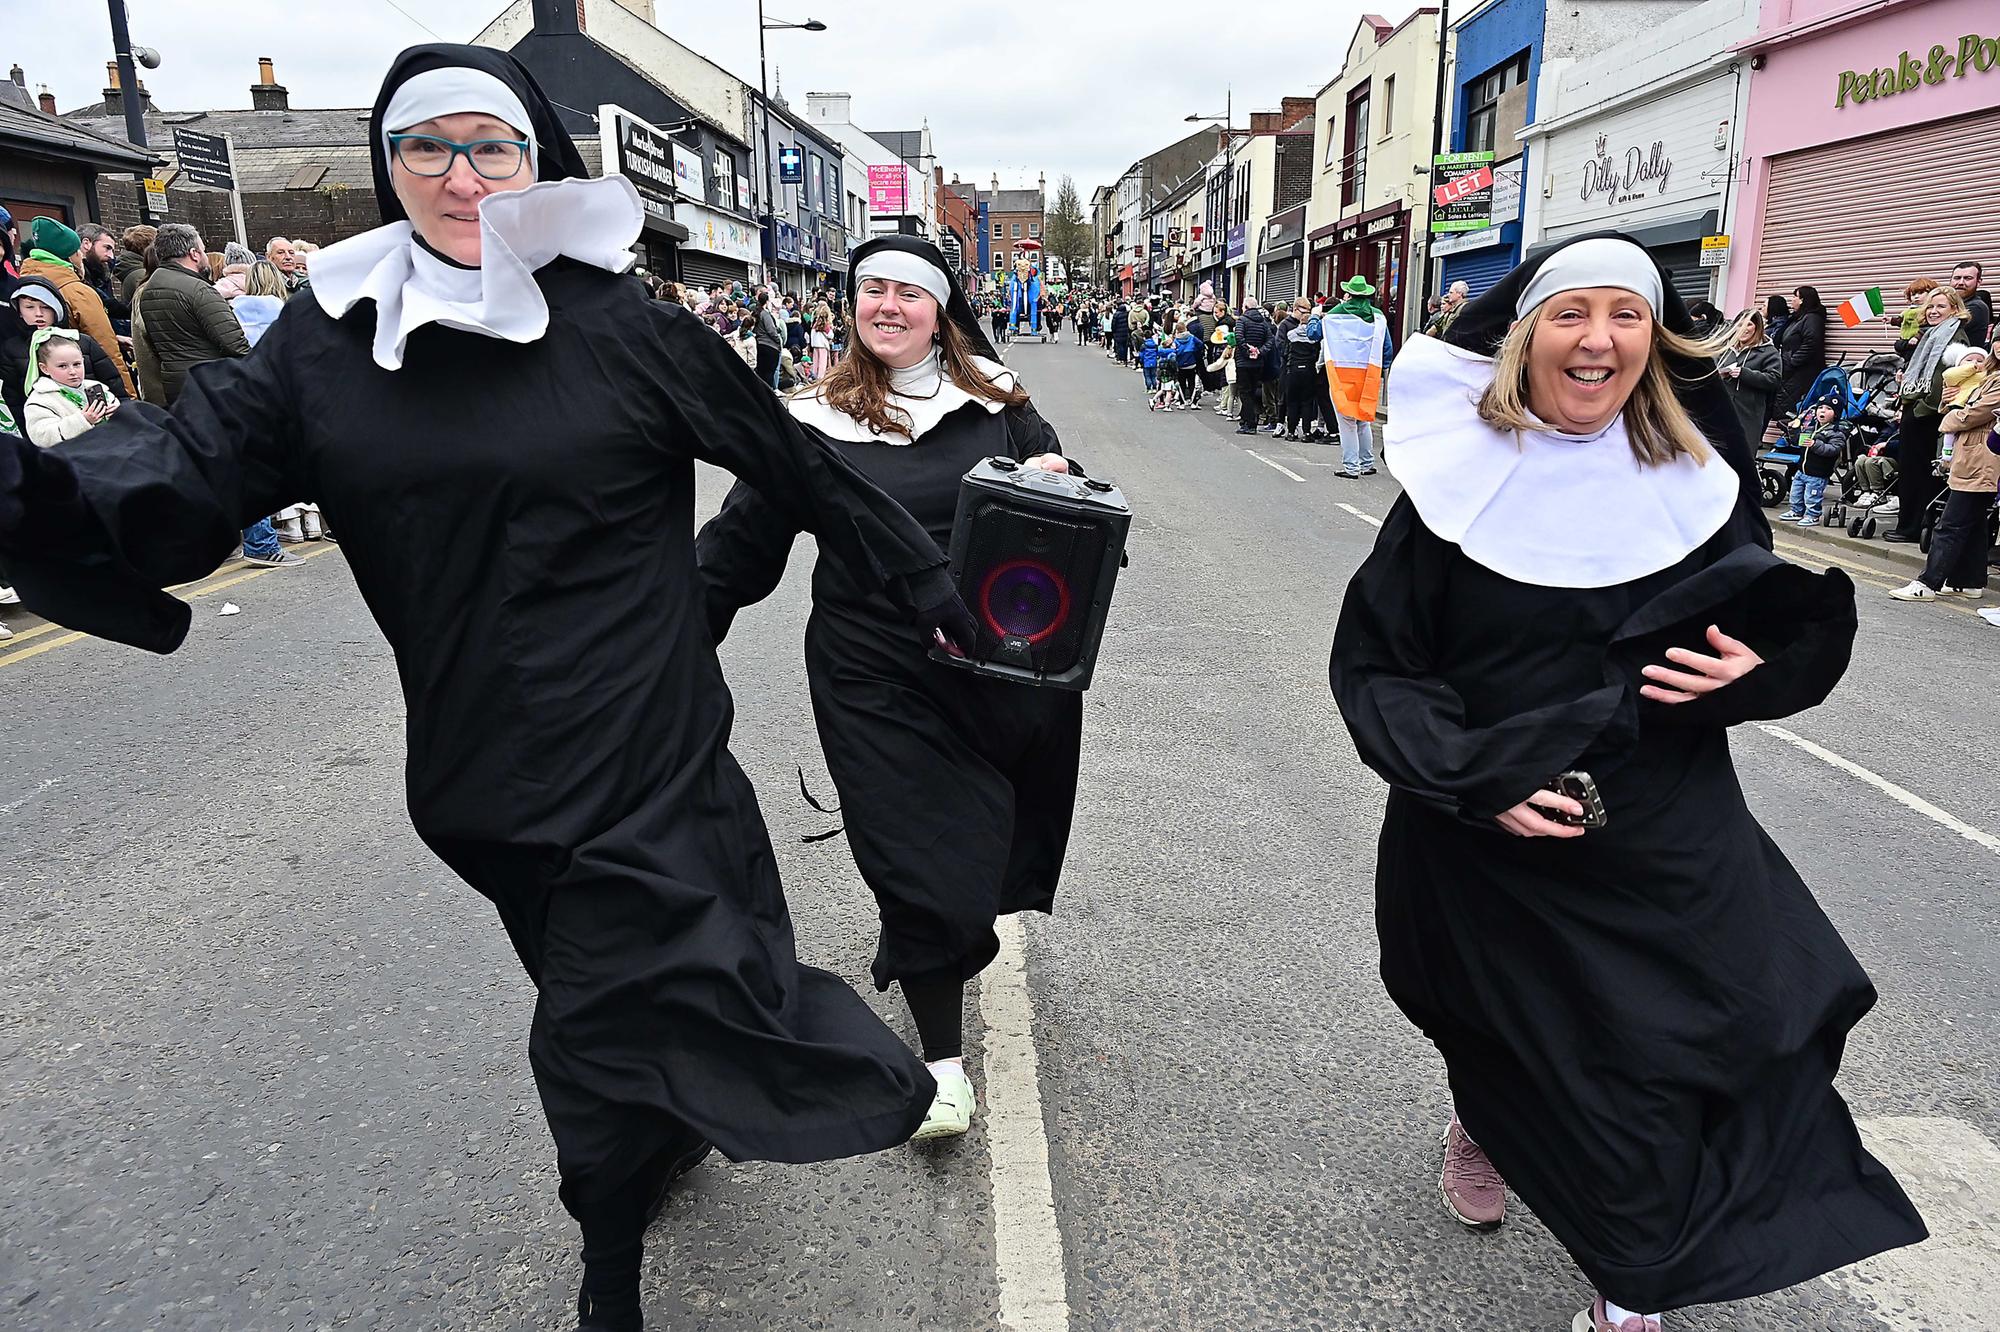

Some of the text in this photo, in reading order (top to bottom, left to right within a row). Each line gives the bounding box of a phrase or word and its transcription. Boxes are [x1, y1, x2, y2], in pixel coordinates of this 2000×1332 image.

[1834, 33, 2000, 109] Petals & Po
[649, 138, 665, 160] Street
[1443, 152, 1484, 163] FOR RENT
[625, 149, 651, 178] TURKISH
[651, 161, 674, 187] BARBER
[1580, 155, 1621, 206] Dilly
[1622, 140, 1673, 194] Dally
[1443, 172, 1482, 201] LET
[1467, 210, 1489, 219] Lettings
